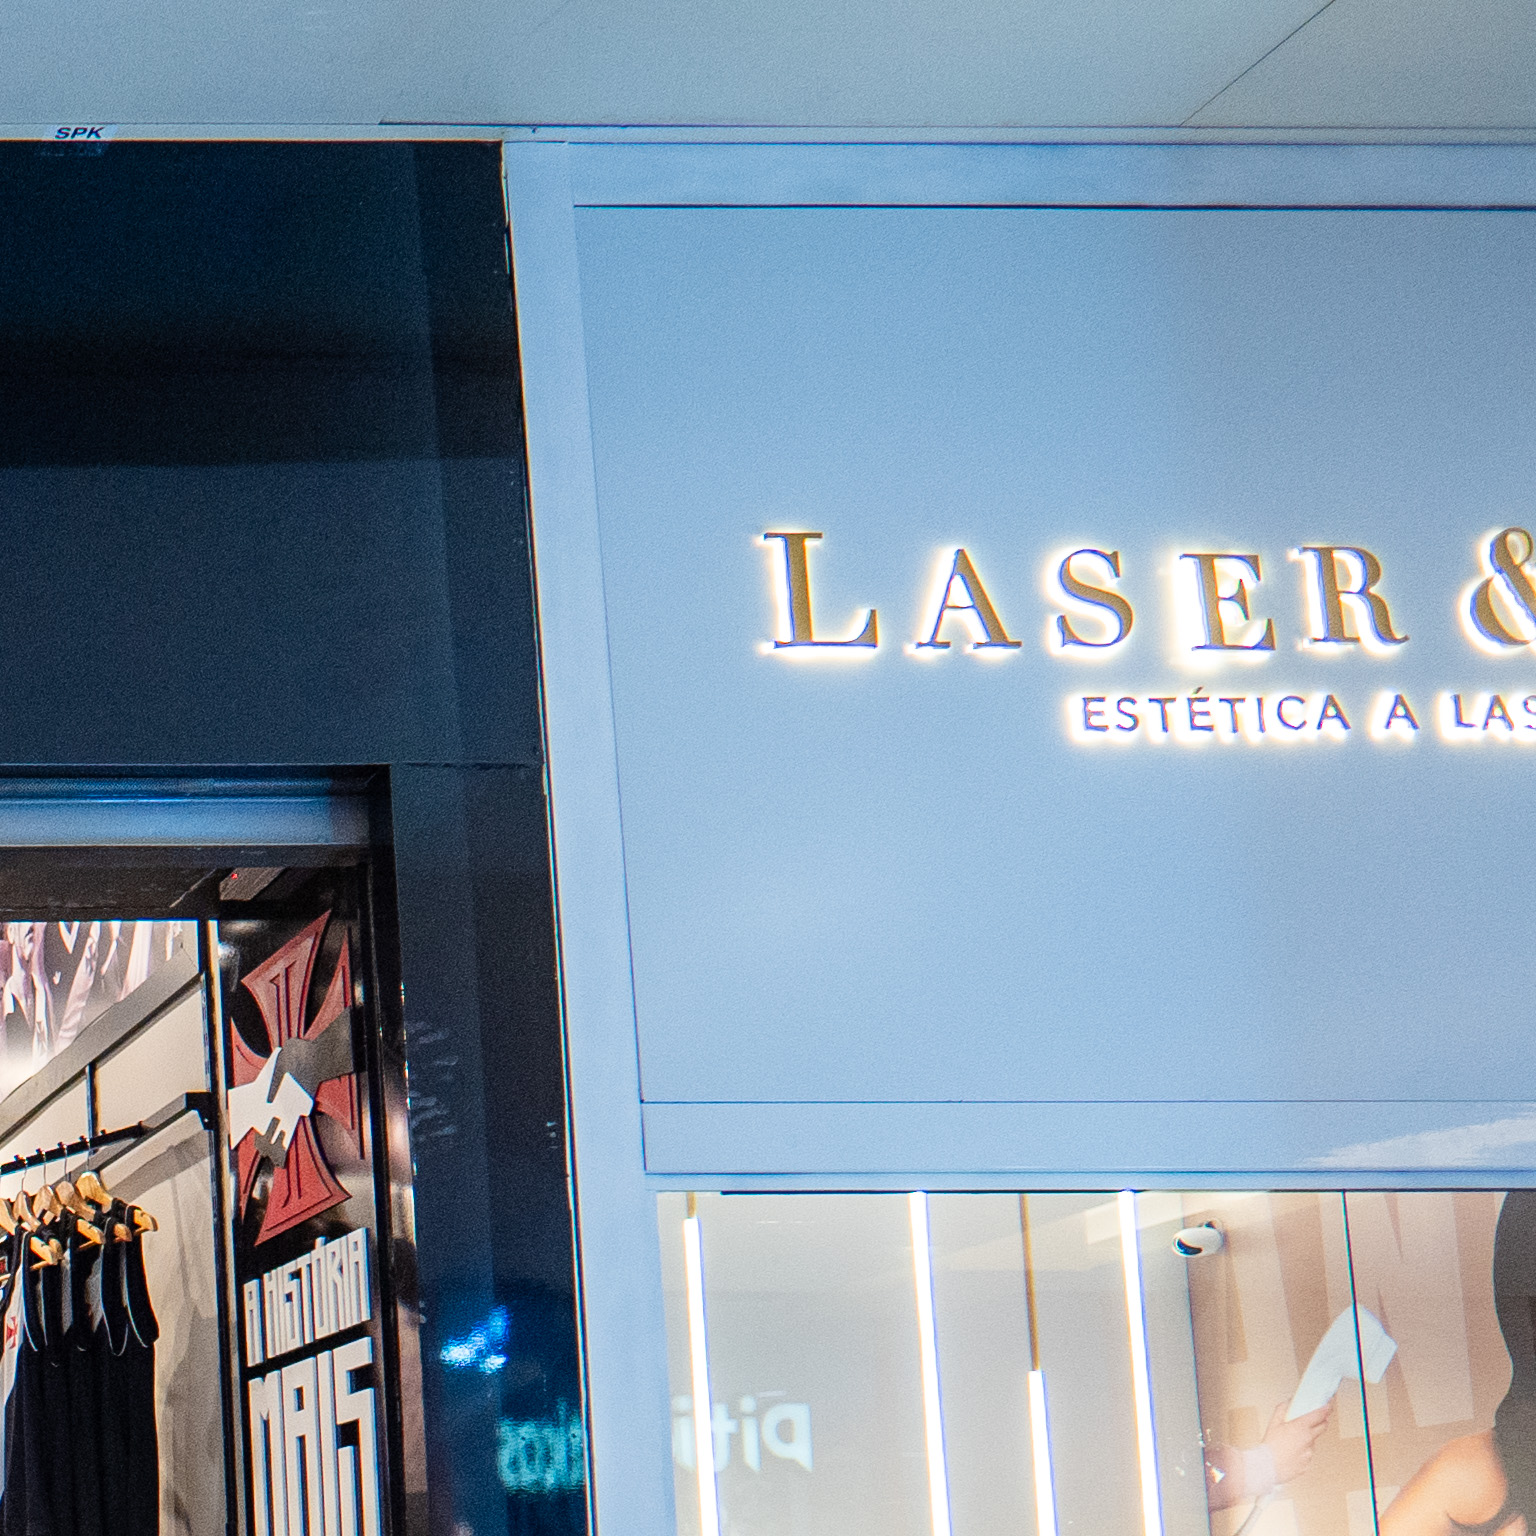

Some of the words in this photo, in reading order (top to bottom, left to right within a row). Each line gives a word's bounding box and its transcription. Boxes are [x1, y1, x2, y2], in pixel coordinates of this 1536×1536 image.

[54, 126, 104, 139] SPK
[762, 530, 1411, 652] LASER
[1081, 686, 1352, 734] ESTÉTICA
[1384, 694, 1421, 731] A
[243, 1278, 264, 1368] A
[264, 1227, 372, 1360] HISTÓRIA
